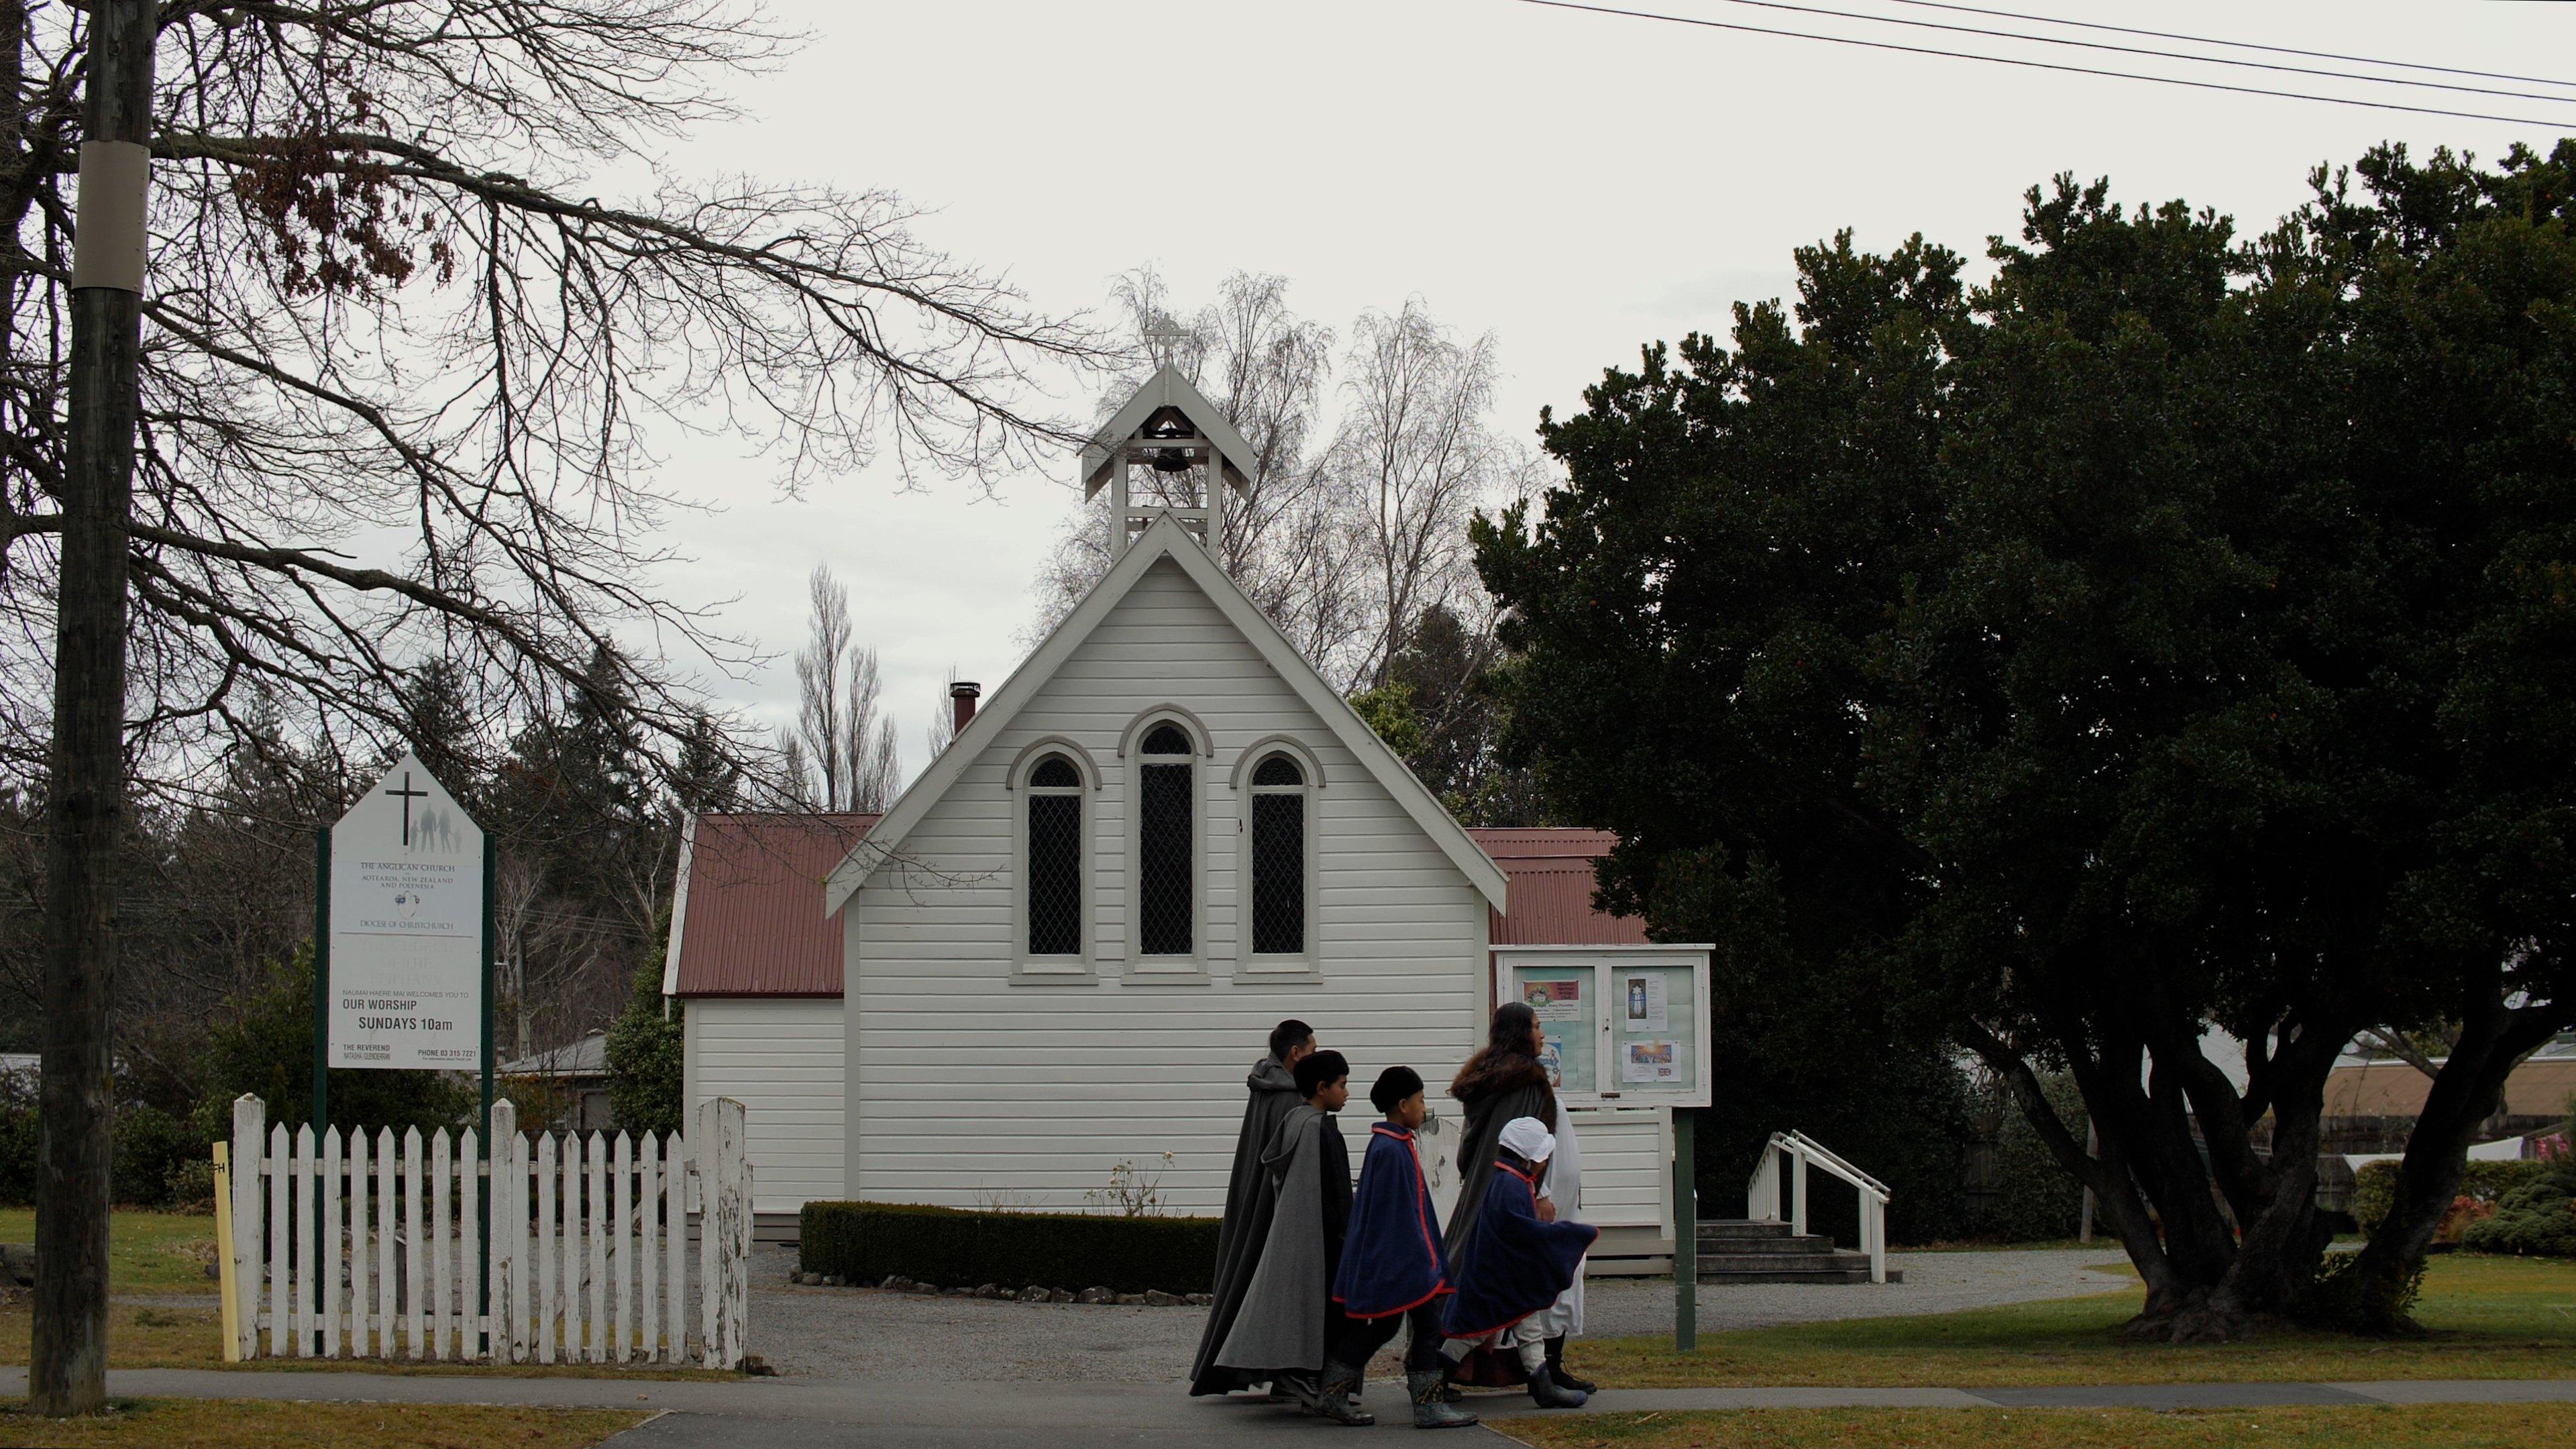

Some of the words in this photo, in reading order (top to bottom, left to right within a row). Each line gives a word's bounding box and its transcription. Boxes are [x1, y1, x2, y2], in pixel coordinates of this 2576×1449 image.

[377, 863, 419, 871] ANGLICAN
[421, 864, 455, 872] CHURCH
[360, 920, 386, 928] DIOCESE
[398, 921, 453, 930] CHRISTCHURCH
[343, 998, 364, 1010] OUR
[368, 999, 417, 1010] WORSHIP
[358, 1016, 417, 1030] SUNDAYS
[421, 1018, 453, 1031] 10am
[418, 1049, 439, 1057] PHONE
